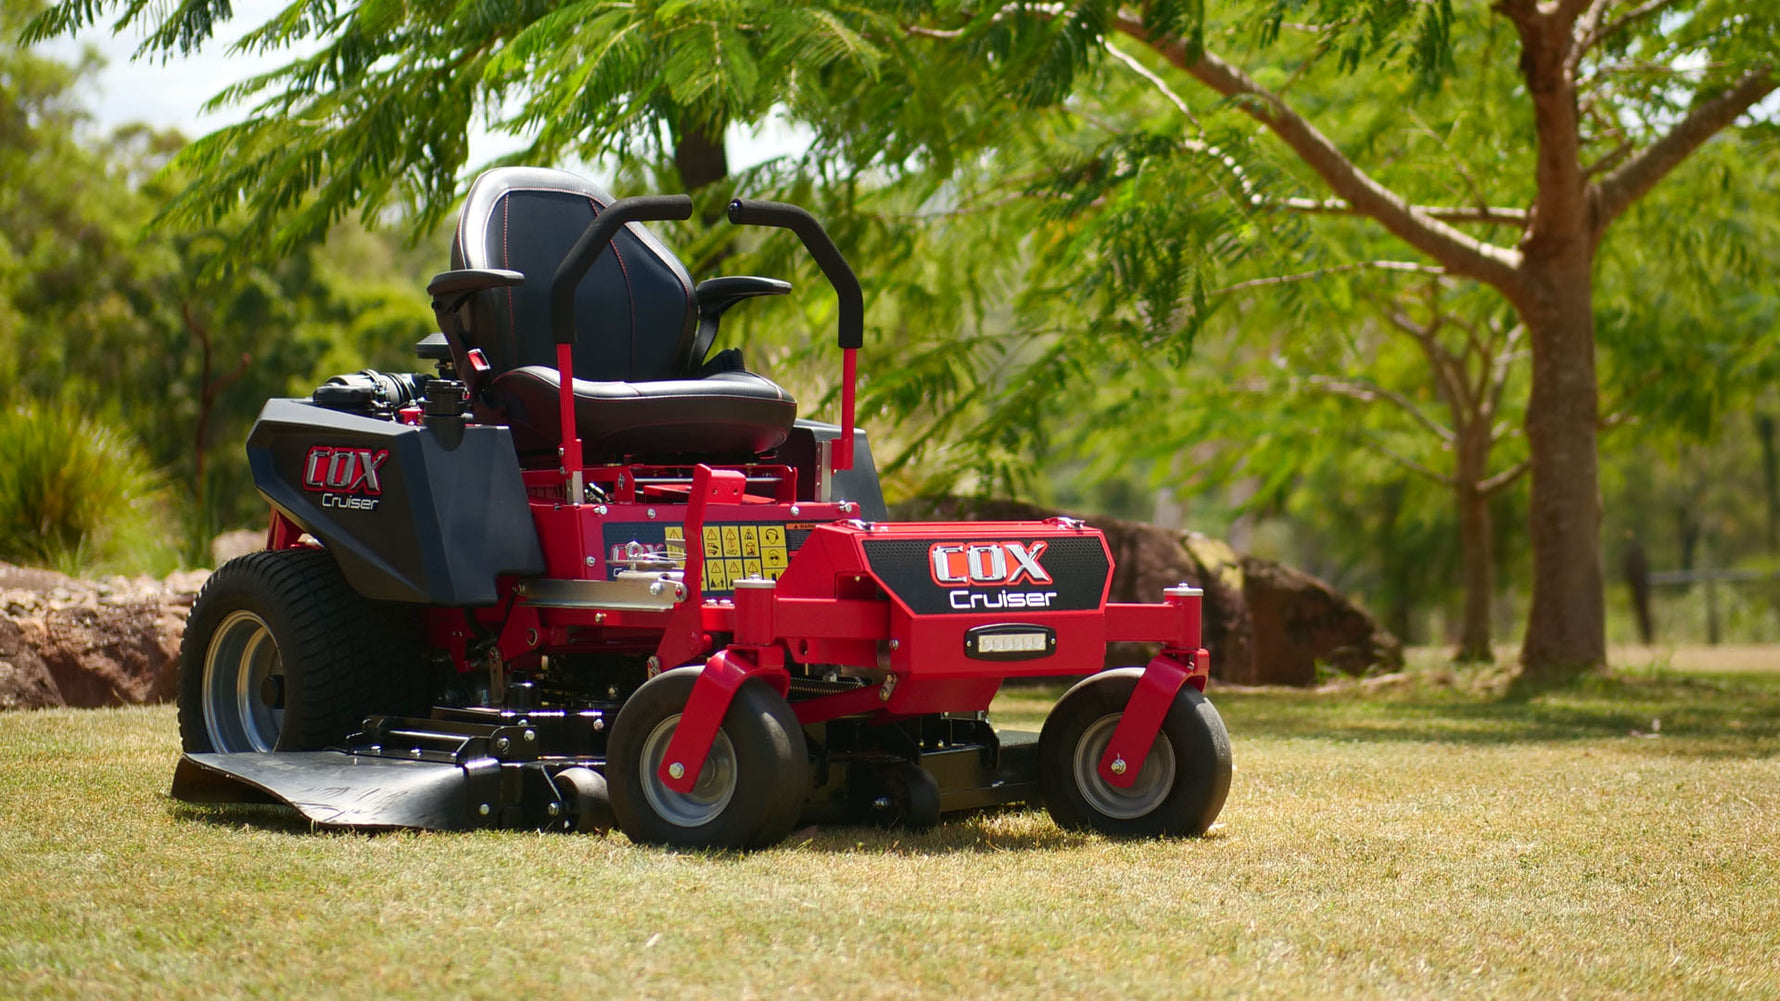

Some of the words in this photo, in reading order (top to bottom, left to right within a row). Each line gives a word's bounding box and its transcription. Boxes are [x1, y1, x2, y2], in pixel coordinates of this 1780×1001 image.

[303, 447, 389, 494] COX
[322, 493, 379, 510] Cruiser
[929, 542, 1052, 586] COX
[950, 590, 1057, 609] Cruiser
